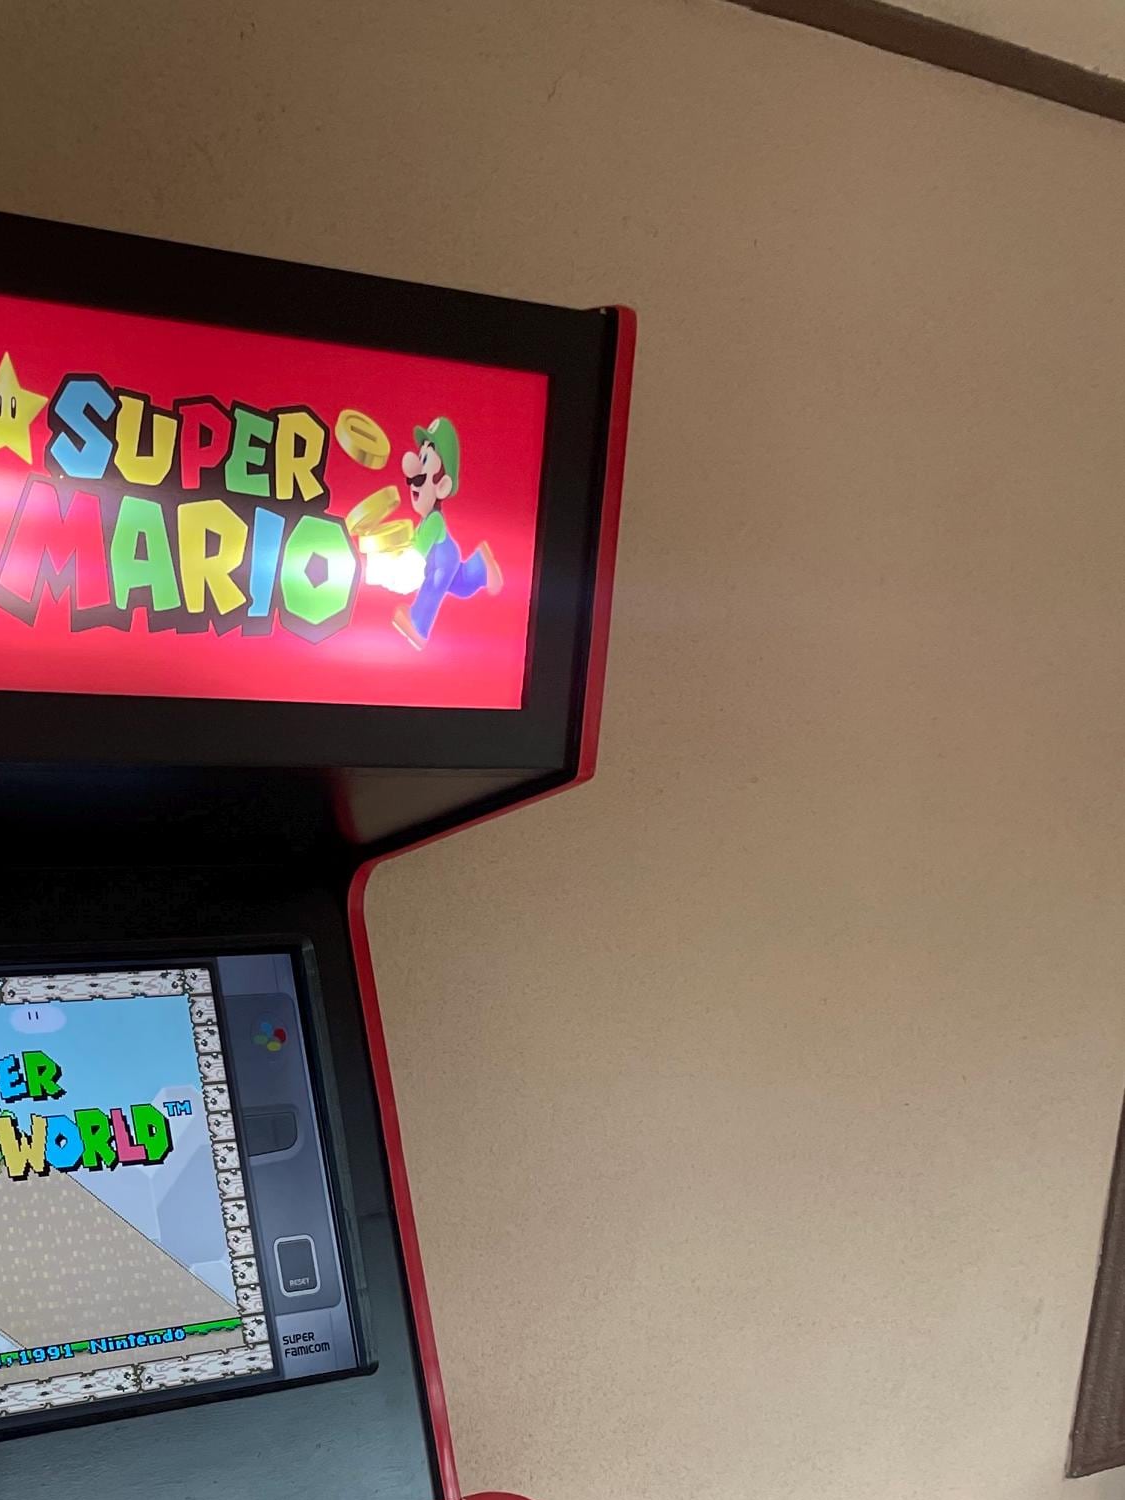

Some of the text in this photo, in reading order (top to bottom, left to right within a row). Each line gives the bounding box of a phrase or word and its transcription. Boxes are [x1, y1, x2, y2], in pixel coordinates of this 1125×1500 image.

[49, 378, 325, 502] SUPER
[289, 1277, 310, 1287] RESET
[89, 1327, 186, 1355] Nintendo
[282, 1331, 315, 1346] SUPER
